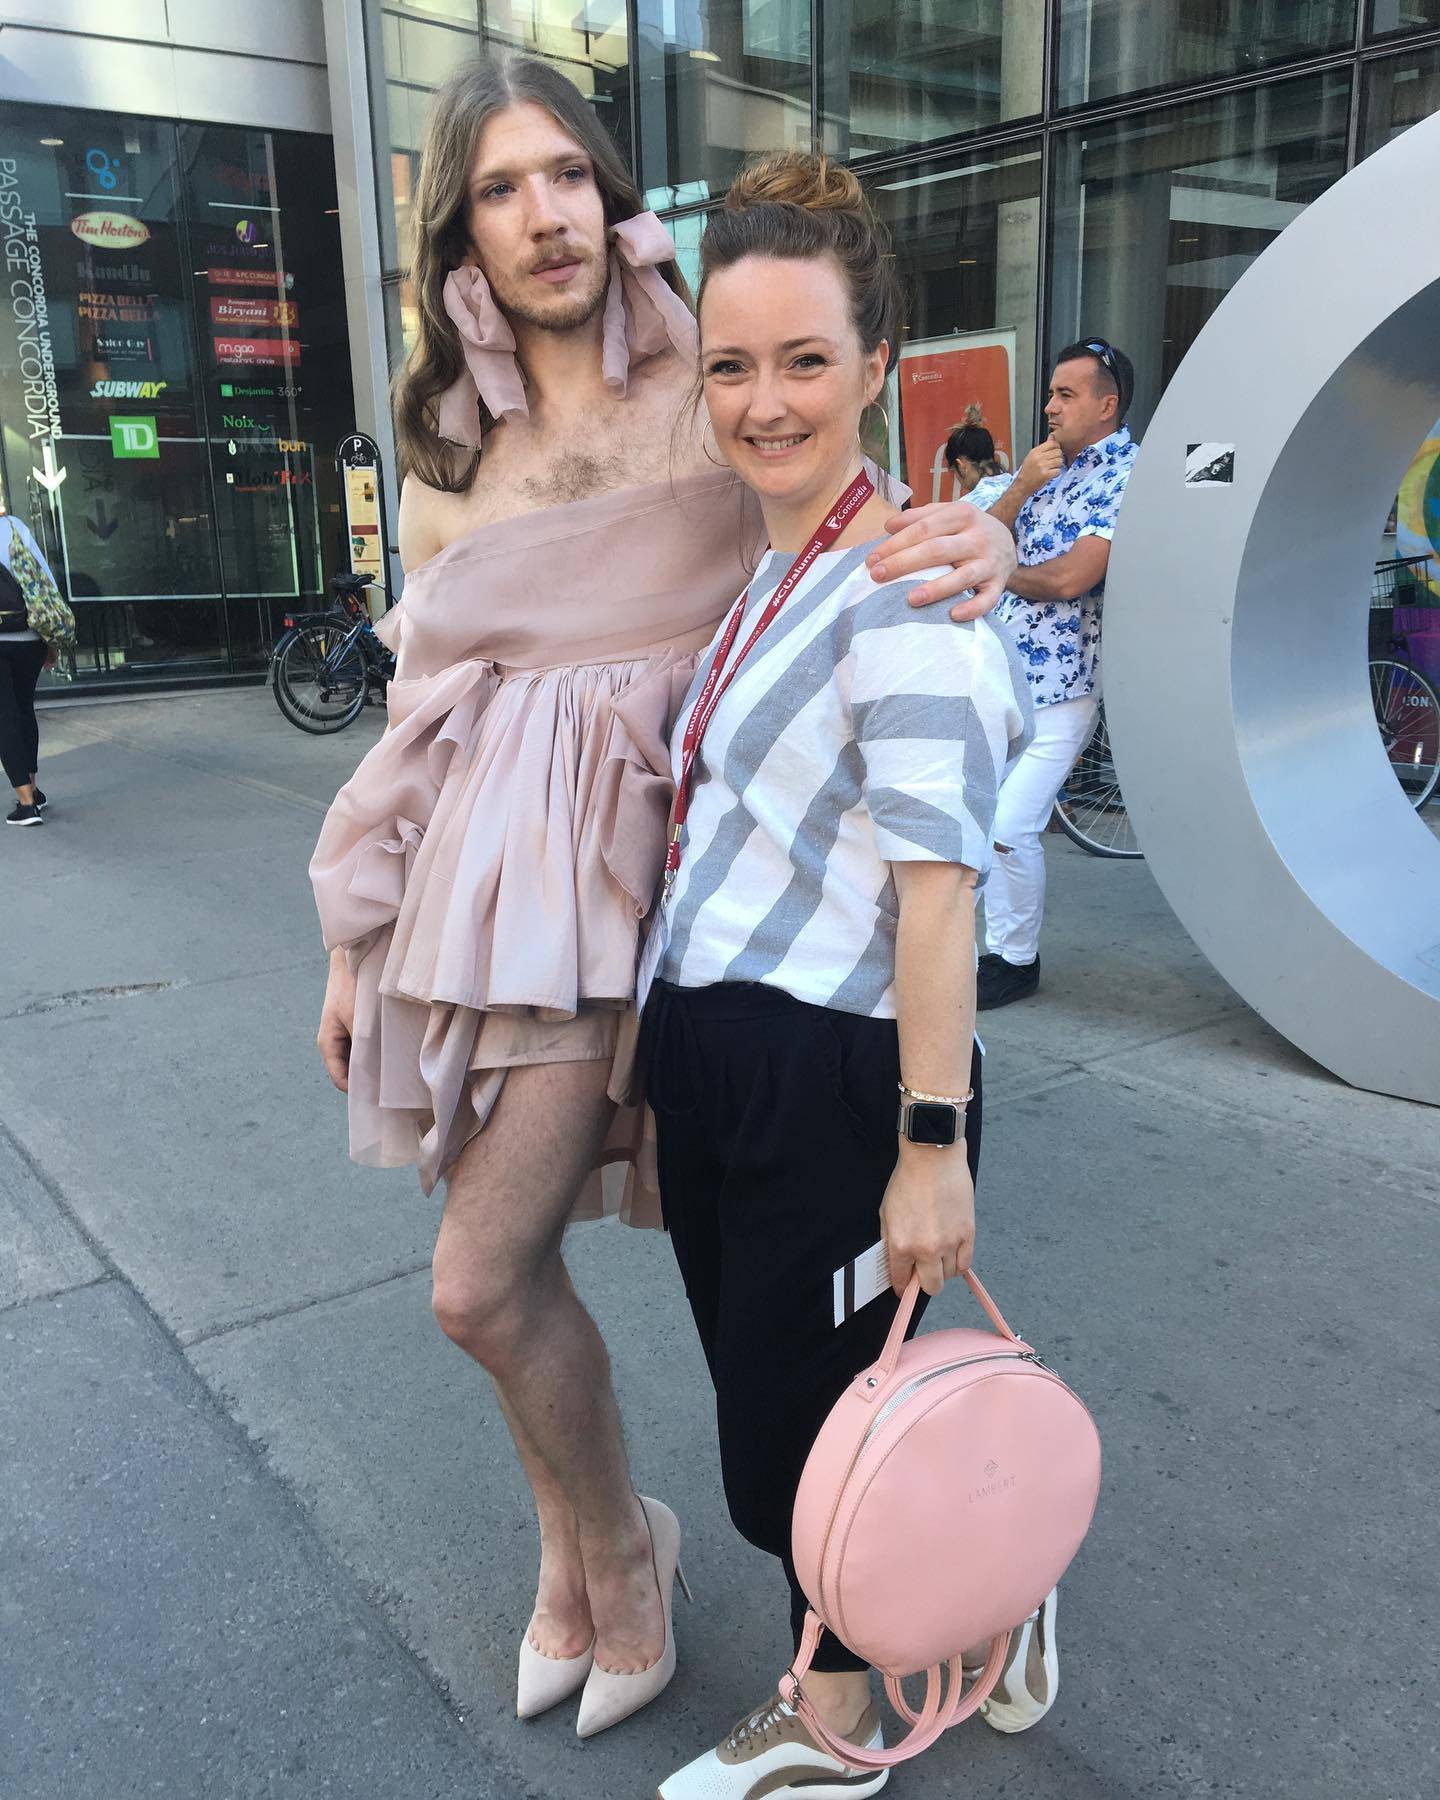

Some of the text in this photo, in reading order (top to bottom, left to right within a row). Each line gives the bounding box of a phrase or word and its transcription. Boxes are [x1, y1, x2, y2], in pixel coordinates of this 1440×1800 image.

[73, 219, 98, 235] Tim
[0, 158, 50, 439] PASSAGE CONCORDIA
[78, 306, 118, 320] PIZZA
[218, 305, 268, 317] Biryani
[24, 212, 62, 440] THE CONCORDIA UNDERGROUND
[89, 380, 167, 398] SUBWAY
[235, 387, 274, 396] Desjardins
[223, 415, 255, 428] Noix
[114, 423, 154, 450] TD
[353, 439, 362, 452] P
[836, 484, 868, 520] Concordia
[772, 540, 823, 607] #CUalumni
[687, 669, 718, 735] #CUalumni
